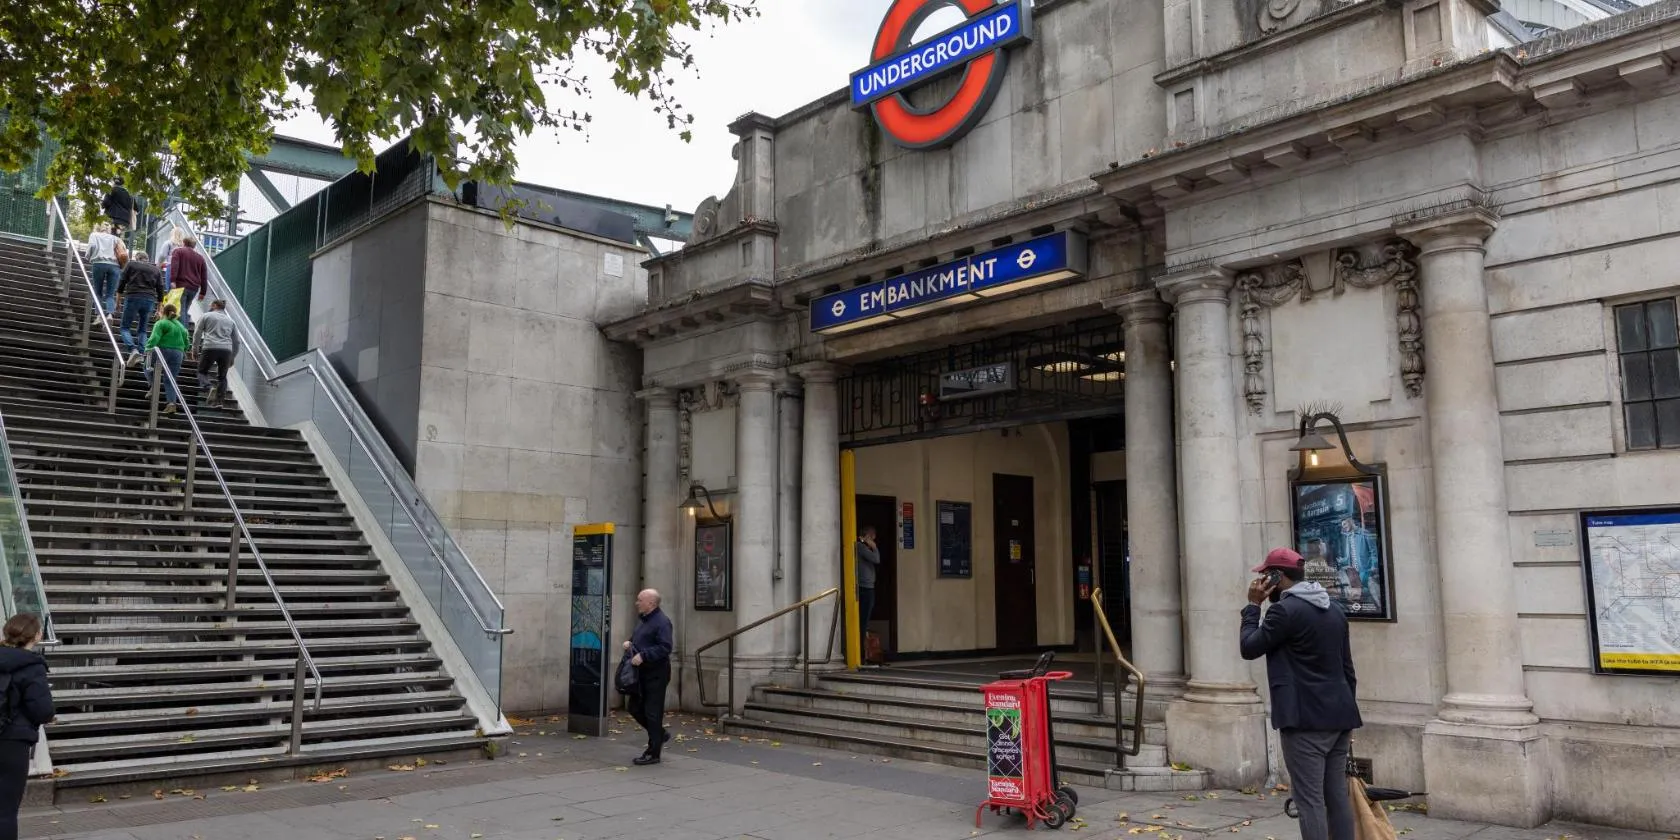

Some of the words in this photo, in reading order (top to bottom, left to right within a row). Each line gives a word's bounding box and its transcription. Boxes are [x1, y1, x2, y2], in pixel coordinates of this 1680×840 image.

[859, 14, 1012, 96] UNDERGROUND
[860, 258, 998, 312] EMBANKMENT
[988, 692, 1016, 702] Evening
[988, 700, 1021, 708] Standard
